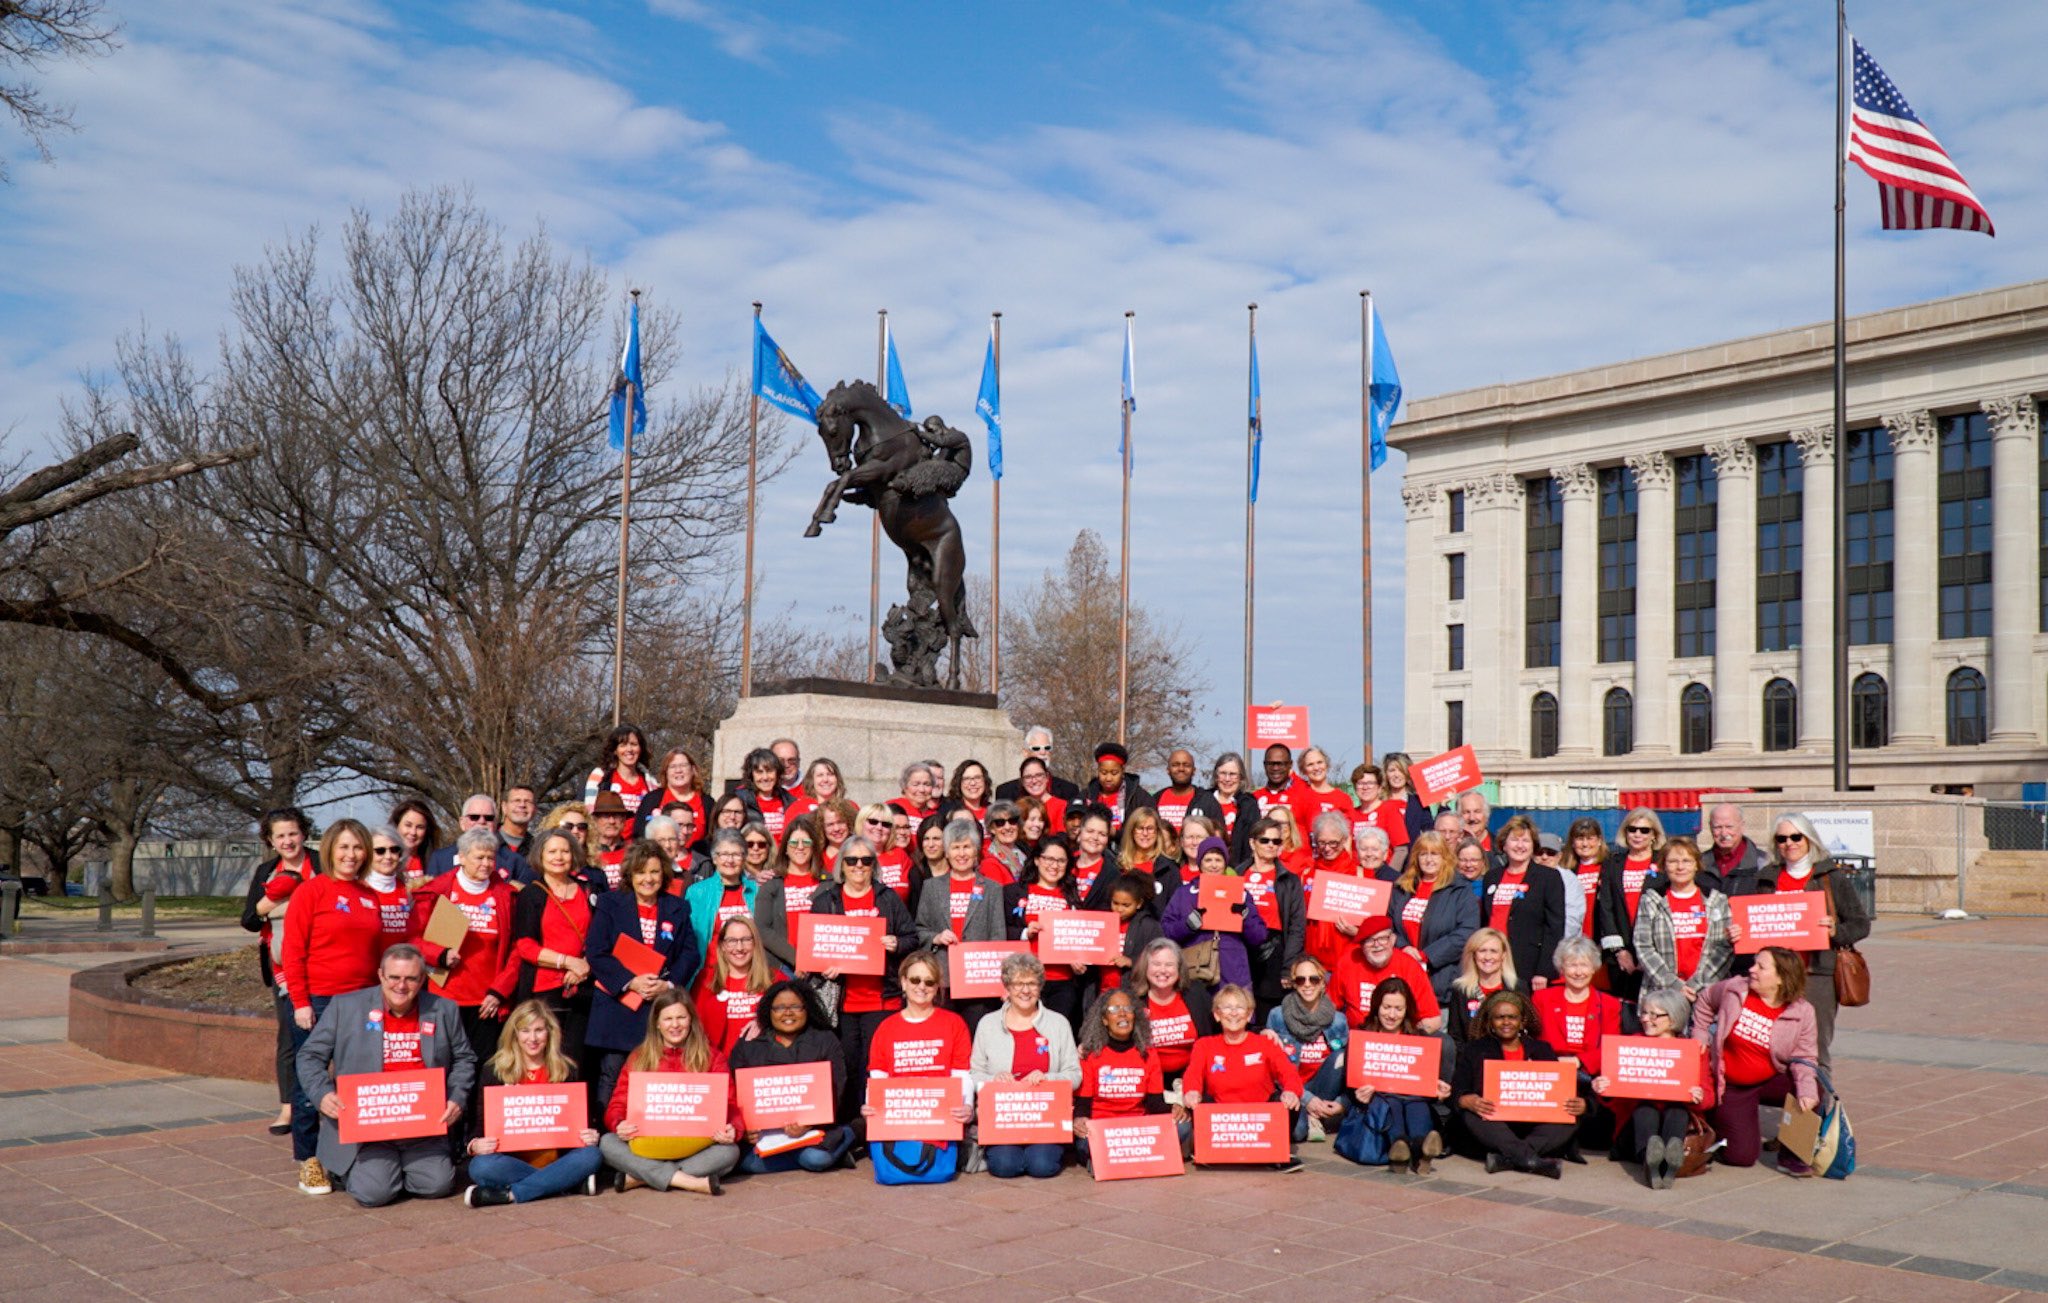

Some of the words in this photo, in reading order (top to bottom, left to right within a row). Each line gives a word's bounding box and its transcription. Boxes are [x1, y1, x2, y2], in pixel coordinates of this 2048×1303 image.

[1422, 762, 1448, 776] MOMS
[1425, 764, 1462, 782] DEMAND
[1428, 772, 1459, 788] ACTION
[1326, 880, 1356, 892] MOMS
[1326, 888, 1369, 902] DEMAND
[1324, 897, 1362, 909] ACTION
[1748, 904, 1784, 914] MOMS
[1749, 912, 1801, 922] DEMAND
[814, 924, 849, 934] MOMS
[1750, 922, 1796, 932] ACTION
[1054, 928, 1100, 937] DEMAND
[814, 934, 864, 944] DEMAND
[1054, 937, 1094, 945] ACTION
[813, 944, 856, 952] ACTION
[964, 952, 998, 960] MOMS
[1151, 1018, 1175, 1028] OMS
[1739, 1015, 1770, 1033] DEMA
[1153, 1032, 1184, 1043] CTION
[1736, 1023, 1769, 1043] ACTIO
[894, 1040, 924, 1049] MOMS
[1365, 1042, 1401, 1052] MOMS
[894, 1048, 938, 1058] DEMAND
[1619, 1046, 1658, 1056] MOMS
[894, 1057, 934, 1066] ACTION
[1364, 1051, 1416, 1064] DEMAND
[1618, 1056, 1674, 1068] DEMAND
[1364, 1061, 1408, 1073] ACTION
[1500, 1072, 1537, 1080] MOMS
[1618, 1067, 1666, 1078] ACTION
[754, 1076, 791, 1087] MOMS
[1500, 1081, 1552, 1090] DEMAND
[358, 1084, 400, 1095] MOMS
[646, 1084, 687, 1093] MOMS
[754, 1085, 808, 1097] DEMAND
[885, 1088, 922, 1097] MOMS
[358, 1094, 418, 1106] DEMAND
[646, 1094, 702, 1104] DEMAND
[995, 1092, 1032, 1101] MOMS
[1500, 1091, 1545, 1100] ACTION
[504, 1096, 545, 1106] MOMS
[755, 1095, 802, 1107] ACTION
[885, 1098, 938, 1108] DEMAND
[358, 1104, 411, 1118] ACTION
[504, 1106, 561, 1116] DEMAND
[646, 1104, 694, 1114] ACTION
[995, 1102, 1048, 1111] DEMAND
[885, 1109, 931, 1118] ACTION
[995, 1112, 1042, 1122] ACTION
[1211, 1114, 1248, 1122] MOMS
[504, 1116, 554, 1126] ACTION
[1104, 1127, 1140, 1138] MOMS
[1211, 1123, 1264, 1132] DEMAND
[1106, 1136, 1156, 1148] DEMAND
[1212, 1133, 1258, 1142] ACTION
[1108, 1146, 1151, 1157] ACTION
